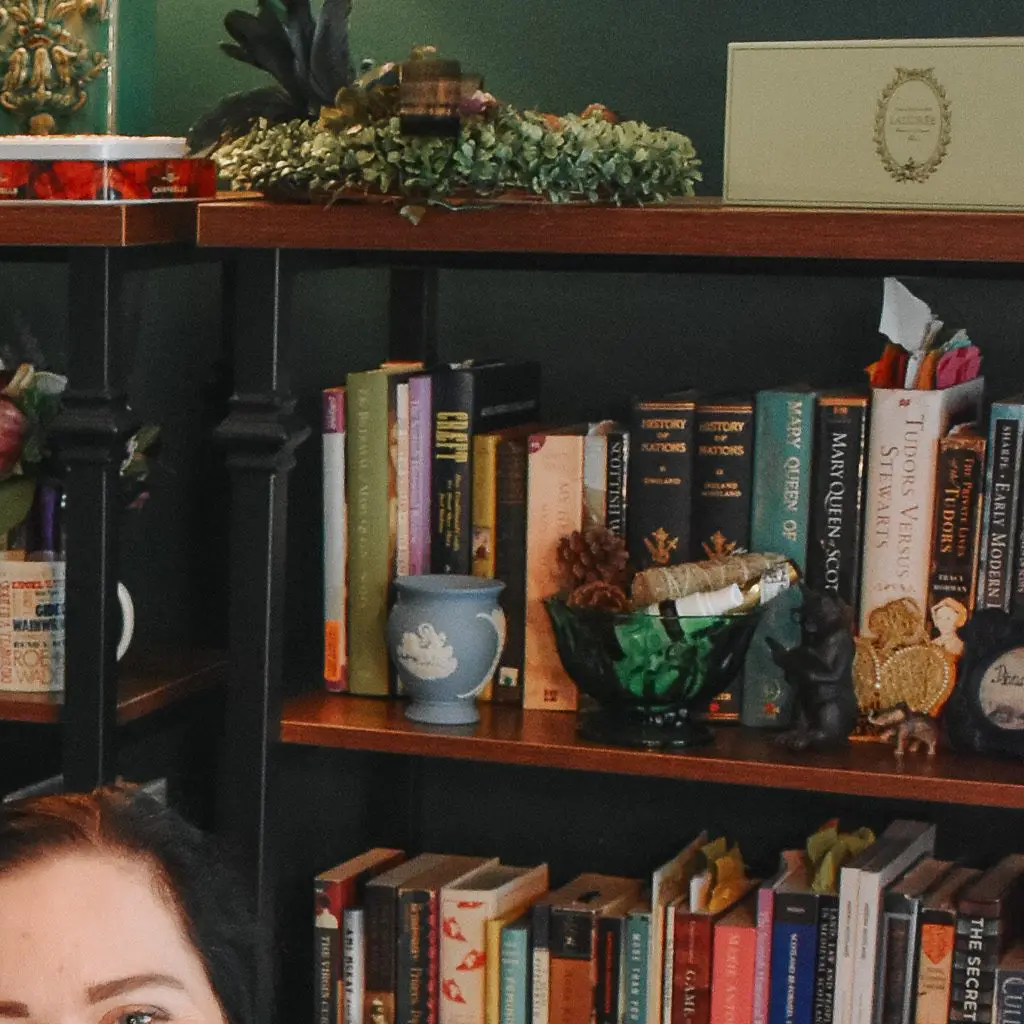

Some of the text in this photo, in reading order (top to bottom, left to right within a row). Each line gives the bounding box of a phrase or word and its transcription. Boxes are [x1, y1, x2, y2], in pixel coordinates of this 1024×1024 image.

[641, 419, 687, 430] HISTORY
[699, 421, 745, 432] HISTORY
[641, 442, 687, 453] NATIONS
[699, 445, 745, 456] NATIONS
[831, 432, 848, 479] MARY
[608, 442, 621, 515] SCOTTISH
[781, 400, 803, 541] MARY QUEEN OF
[824, 482, 846, 538] QUEEN
[875, 446, 899, 550] STEWARTS
[897, 414, 925, 578] TUDORS VERSUS
[987, 426, 1012, 597] SHARPE EARLY MODERN
[940, 486, 960, 553] TUDORS
[825, 548, 842, 592] SCOT
[320, 936, 331, 958] THE
[345, 929, 354, 951] AMI
[631, 932, 642, 961] MORE
[969, 917, 985, 949] THE
[320, 961, 331, 999] VIRGIN
[631, 968, 641, 995] THAN
[683, 969, 696, 1017] GAME
[826, 970, 834, 990] AND
[963, 955, 981, 1020] SECRET
[630, 1000, 640, 1021] YOU
